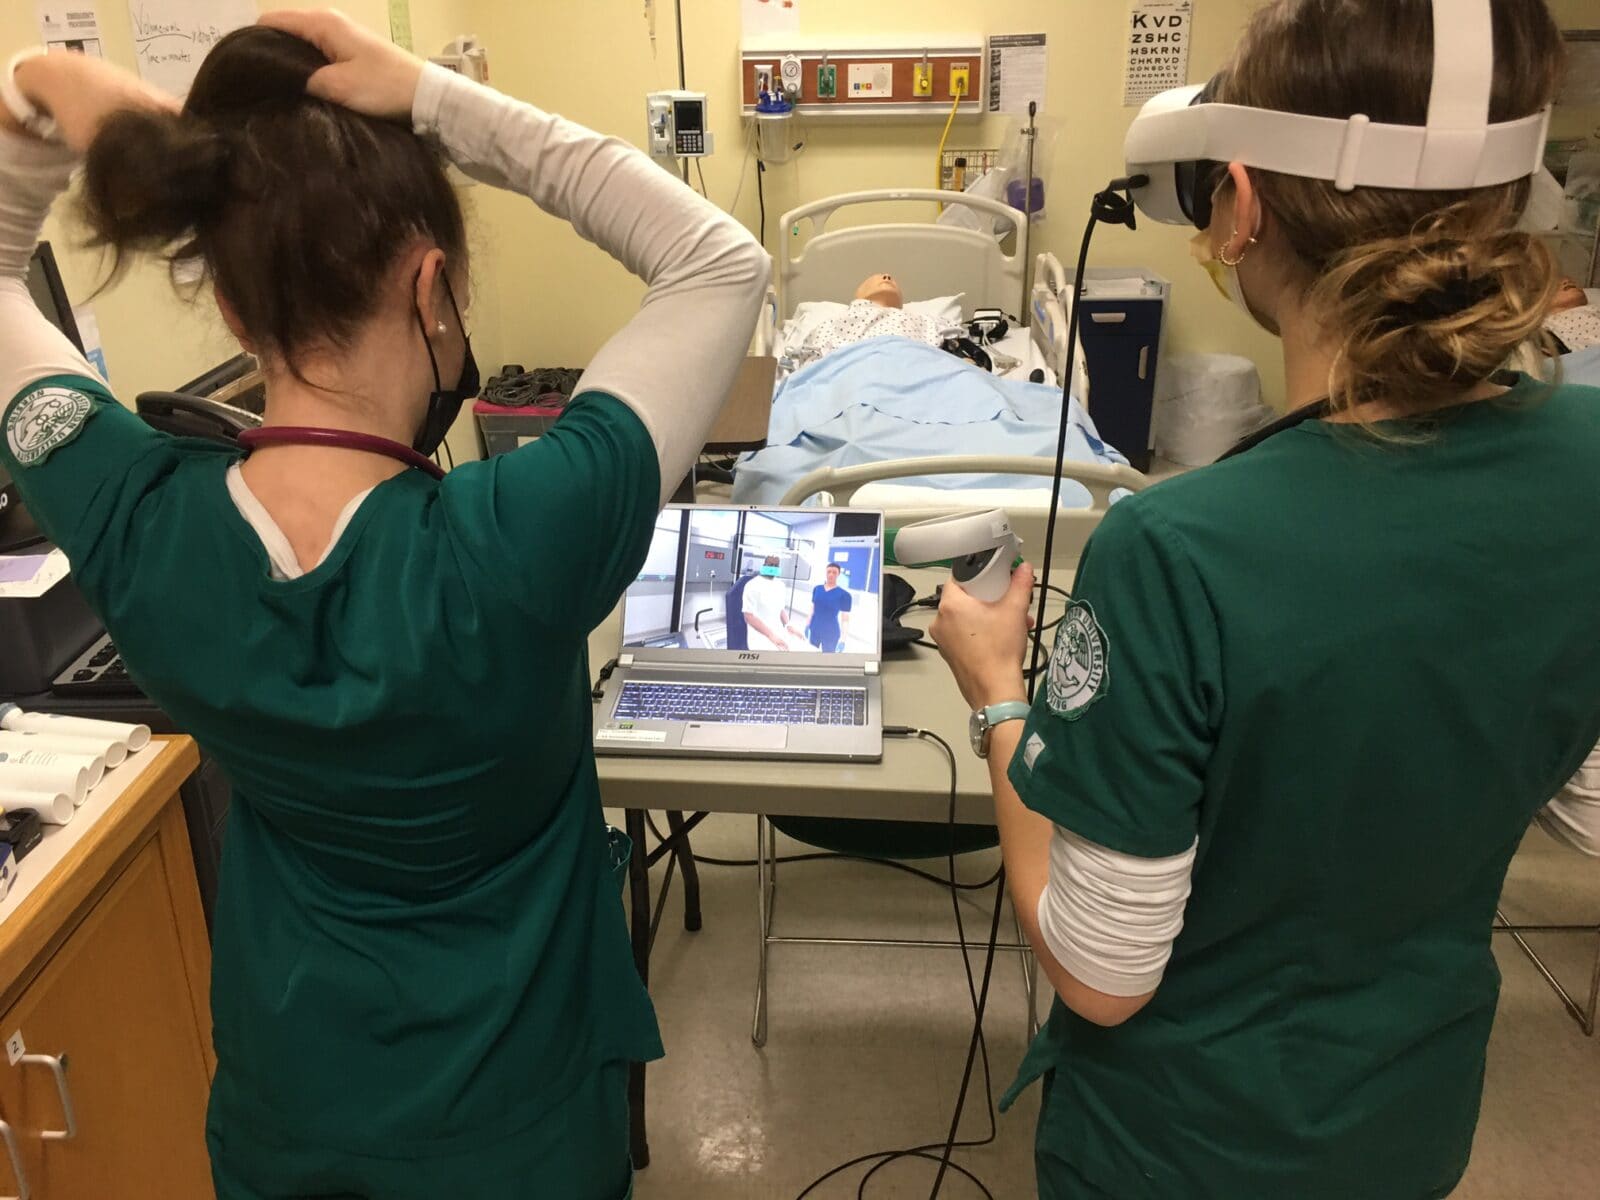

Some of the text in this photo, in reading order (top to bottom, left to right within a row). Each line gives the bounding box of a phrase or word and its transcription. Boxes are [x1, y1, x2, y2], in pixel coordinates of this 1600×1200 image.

[1133, 14, 1182, 29] KVD
[1132, 32, 1181, 44] ZSHC
[1131, 47, 1180, 55] HSKRN
[1131, 57, 1179, 65] CHKRVD
[17, 432, 66, 461] UNIVERSITY
[1082, 615, 1103, 693] UNIVERSITY
[12, 1040, 19, 1054] 2
